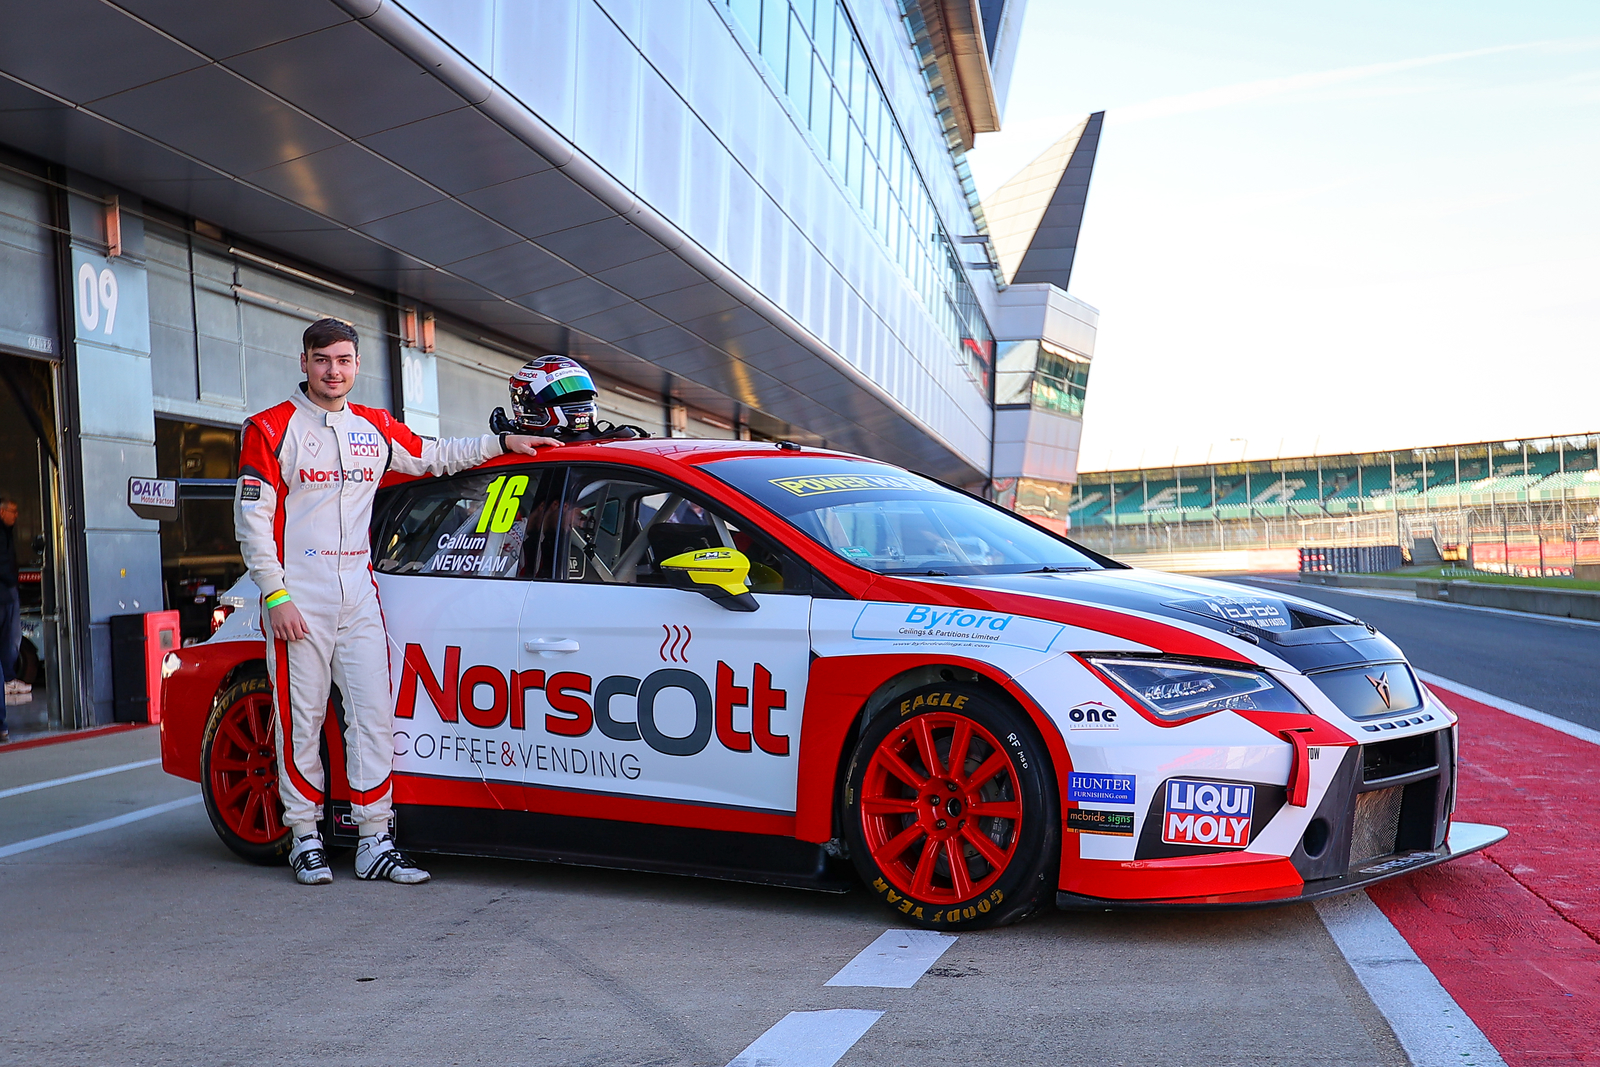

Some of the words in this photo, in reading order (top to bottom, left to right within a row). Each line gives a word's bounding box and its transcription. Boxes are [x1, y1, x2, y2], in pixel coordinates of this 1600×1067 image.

[78, 262, 118, 335] 09
[404, 355, 424, 404] 08
[348, 433, 378, 445] LIQUI
[350, 444, 379, 457] MOLY
[131, 480, 163, 497] OAK
[779, 477, 873, 493] POWER
[156, 497, 175, 505] Factors
[475, 474, 530, 533] 16
[437, 533, 486, 550] Callum
[430, 554, 509, 573] NEWSHAM
[904, 605, 1014, 631] Byford
[898, 627, 926, 637] Ceilings
[927, 628, 934, 636] &
[935, 629, 970, 639] Partitions
[971, 632, 1000, 641] Limited
[393, 641, 791, 757] Norscott
[900, 692, 970, 717] EAGLE
[1069, 708, 1118, 723] one
[1006, 732, 1021, 747] RF
[392, 729, 642, 781] COFFEE&VENDING
[1308, 747, 1321, 760] OW
[1072, 776, 1132, 791] HUNTER
[1073, 790, 1128, 800] FURNISHING.com
[1170, 783, 1250, 814] LIQUI
[1070, 810, 1106, 822] mcbride
[1107, 813, 1131, 825] signs
[1167, 813, 1250, 844] MOLY
